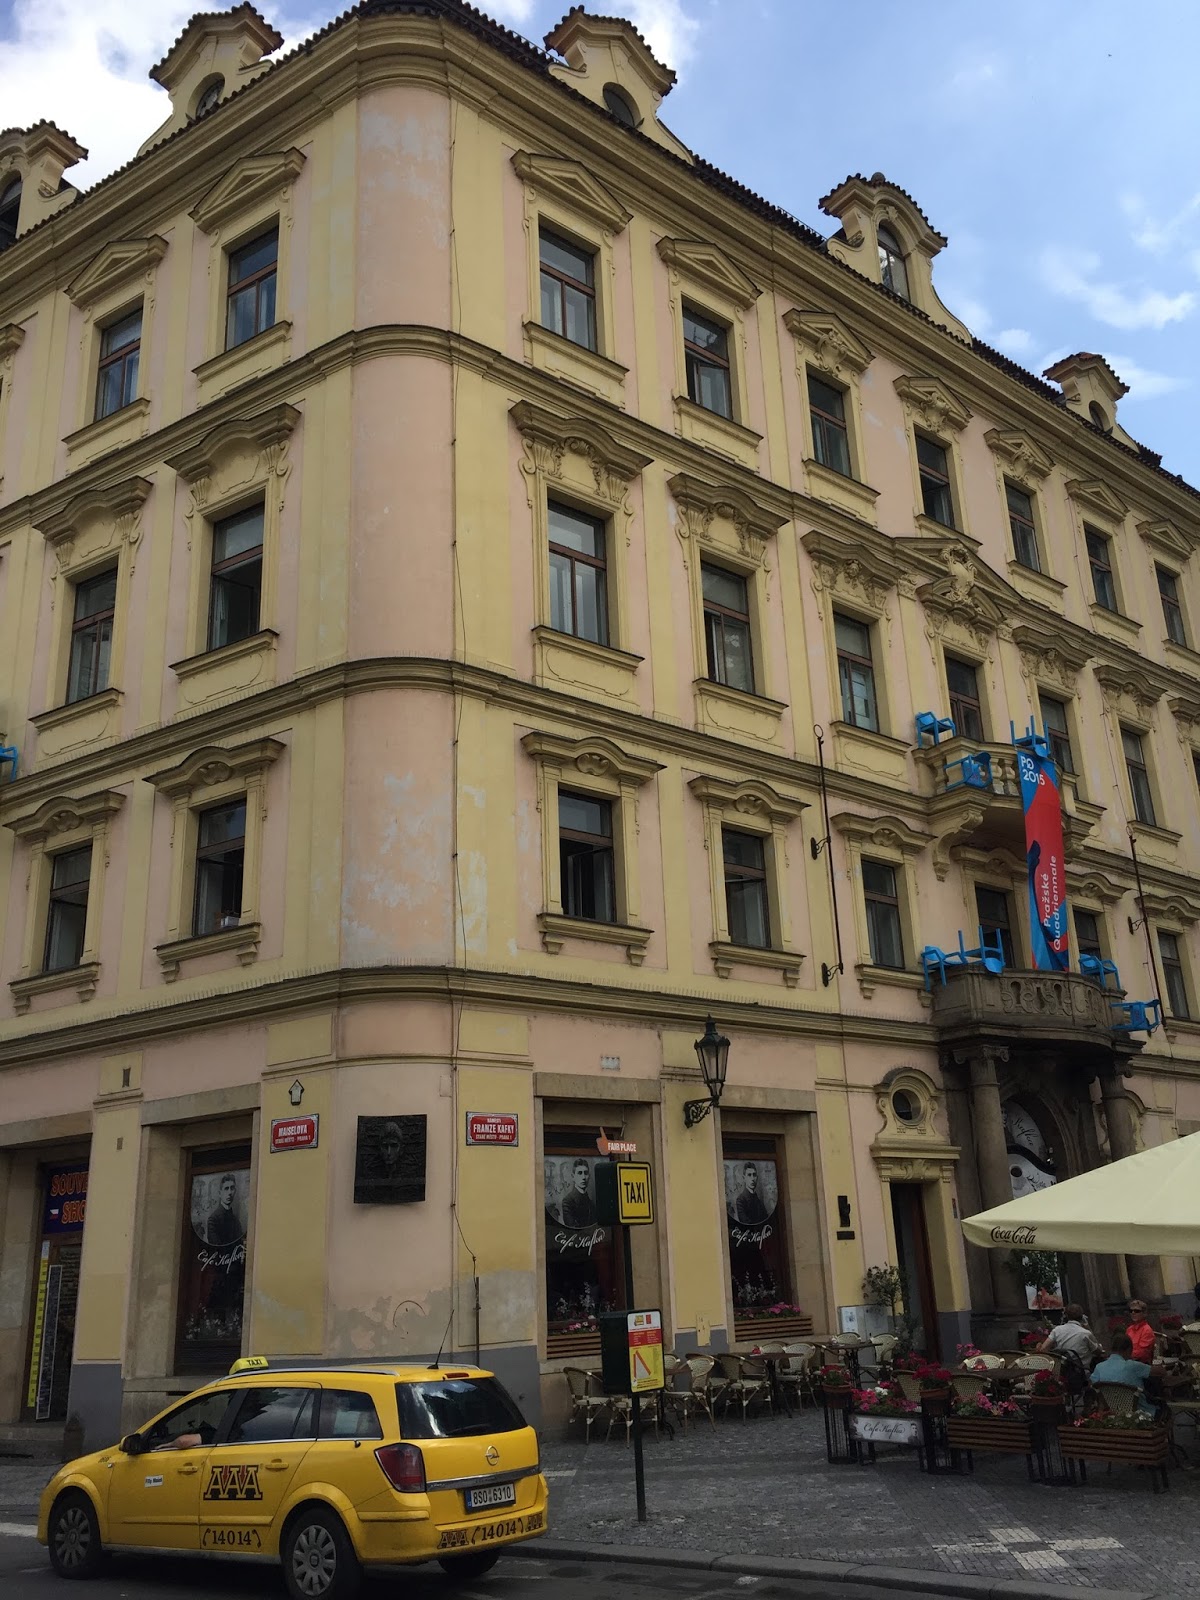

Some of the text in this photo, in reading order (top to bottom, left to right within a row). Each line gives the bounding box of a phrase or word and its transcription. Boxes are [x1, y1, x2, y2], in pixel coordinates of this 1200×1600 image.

[1022, 769, 1046, 786] 2015
[1041, 873, 1051, 927] Pražské
[1050, 855, 1061, 951] Quadriennale
[278, 1124, 308, 1138] MAISELOVA
[473, 1123, 515, 1134] FRANZE KAFKY
[607, 1142, 637, 1152] FAIR PLACE
[623, 1181, 646, 1204] TAXI
[575, 1227, 606, 1256] Kafka
[748, 1224, 773, 1250] Kafka
[246, 1358, 263, 1367] TAXI
[879, 1422, 906, 1440] Kafka
[203, 1465, 263, 1500] AAA
[492, 1486, 512, 1502] 6310
[211, 1529, 252, 1546] 14014
[437, 1529, 469, 1549] AAA
[480, 1520, 517, 1542] 14014
